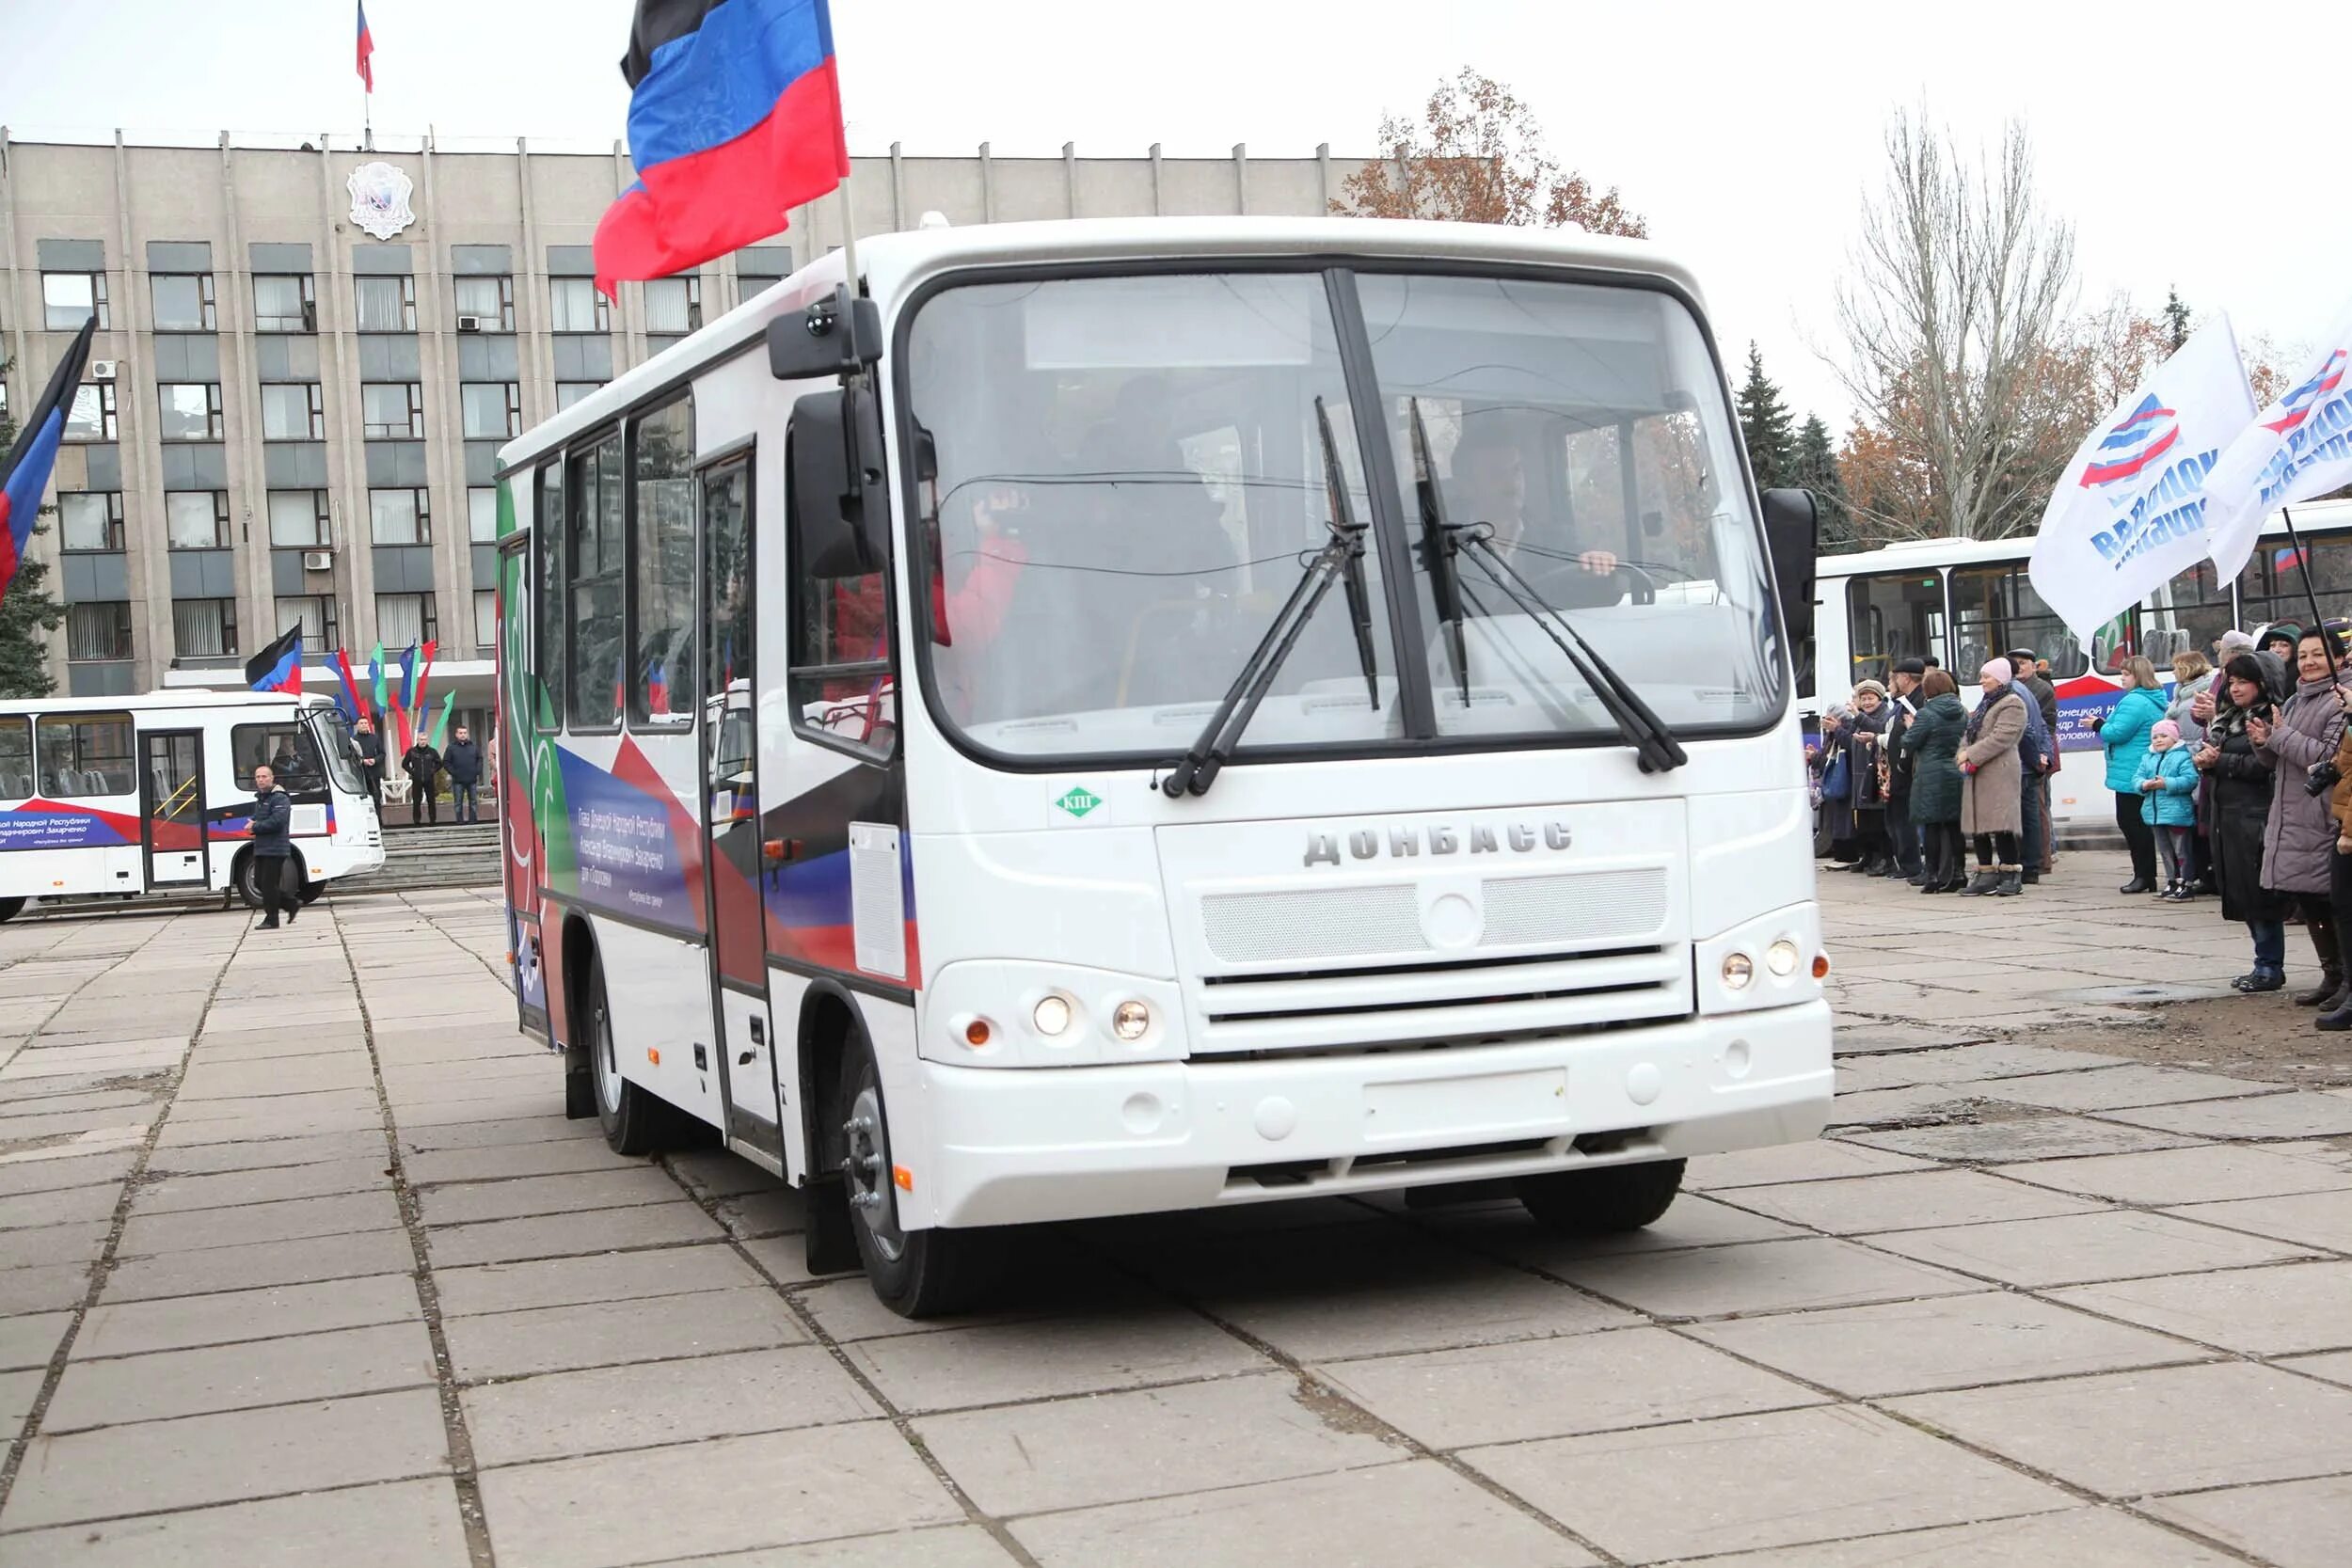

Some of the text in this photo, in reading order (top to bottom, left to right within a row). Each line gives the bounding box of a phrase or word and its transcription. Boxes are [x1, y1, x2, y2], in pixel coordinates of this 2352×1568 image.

[2056, 705, 2102, 718] онецкой
[2056, 731, 2096, 743] рловки
[0, 829, 44, 837] ладимирович
[1304, 819, 1573, 867] ДОНБАСС
